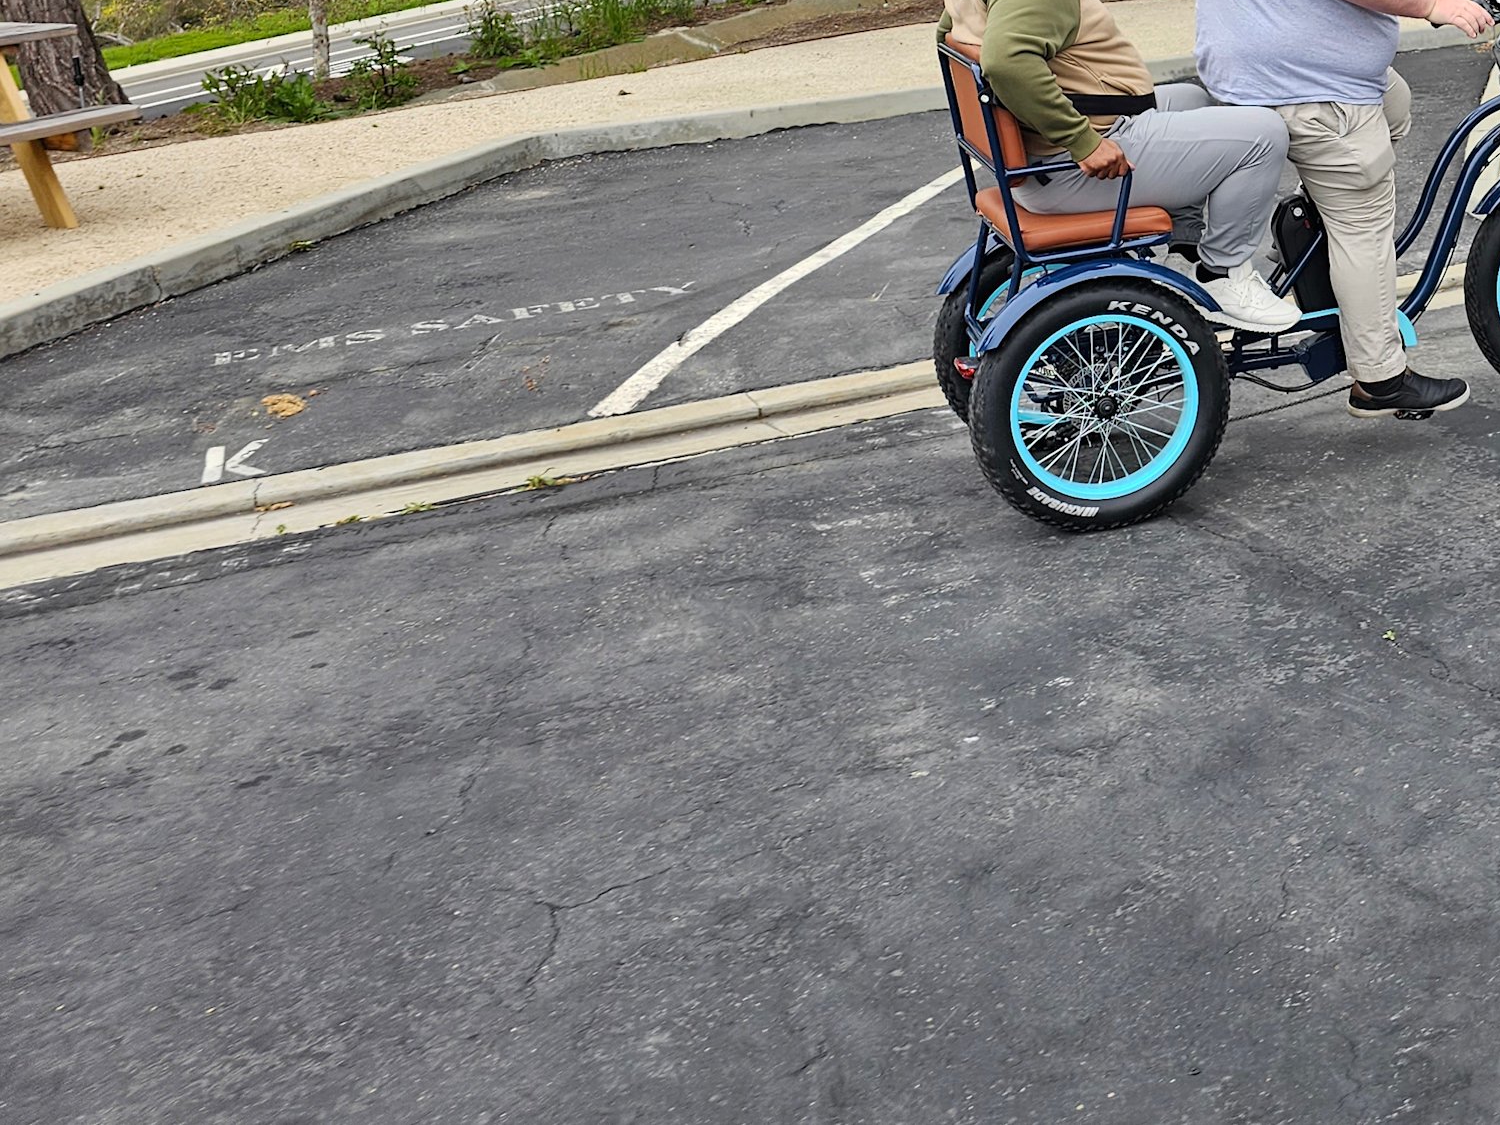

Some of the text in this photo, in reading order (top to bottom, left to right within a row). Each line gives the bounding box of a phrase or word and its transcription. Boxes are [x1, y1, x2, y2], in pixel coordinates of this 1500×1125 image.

[408, 280, 696, 335] SAFETY
[1107, 300, 1201, 356] KENDA
[201, 438, 270, 483] K
[1026, 486, 1084, 516] KRUSADE
